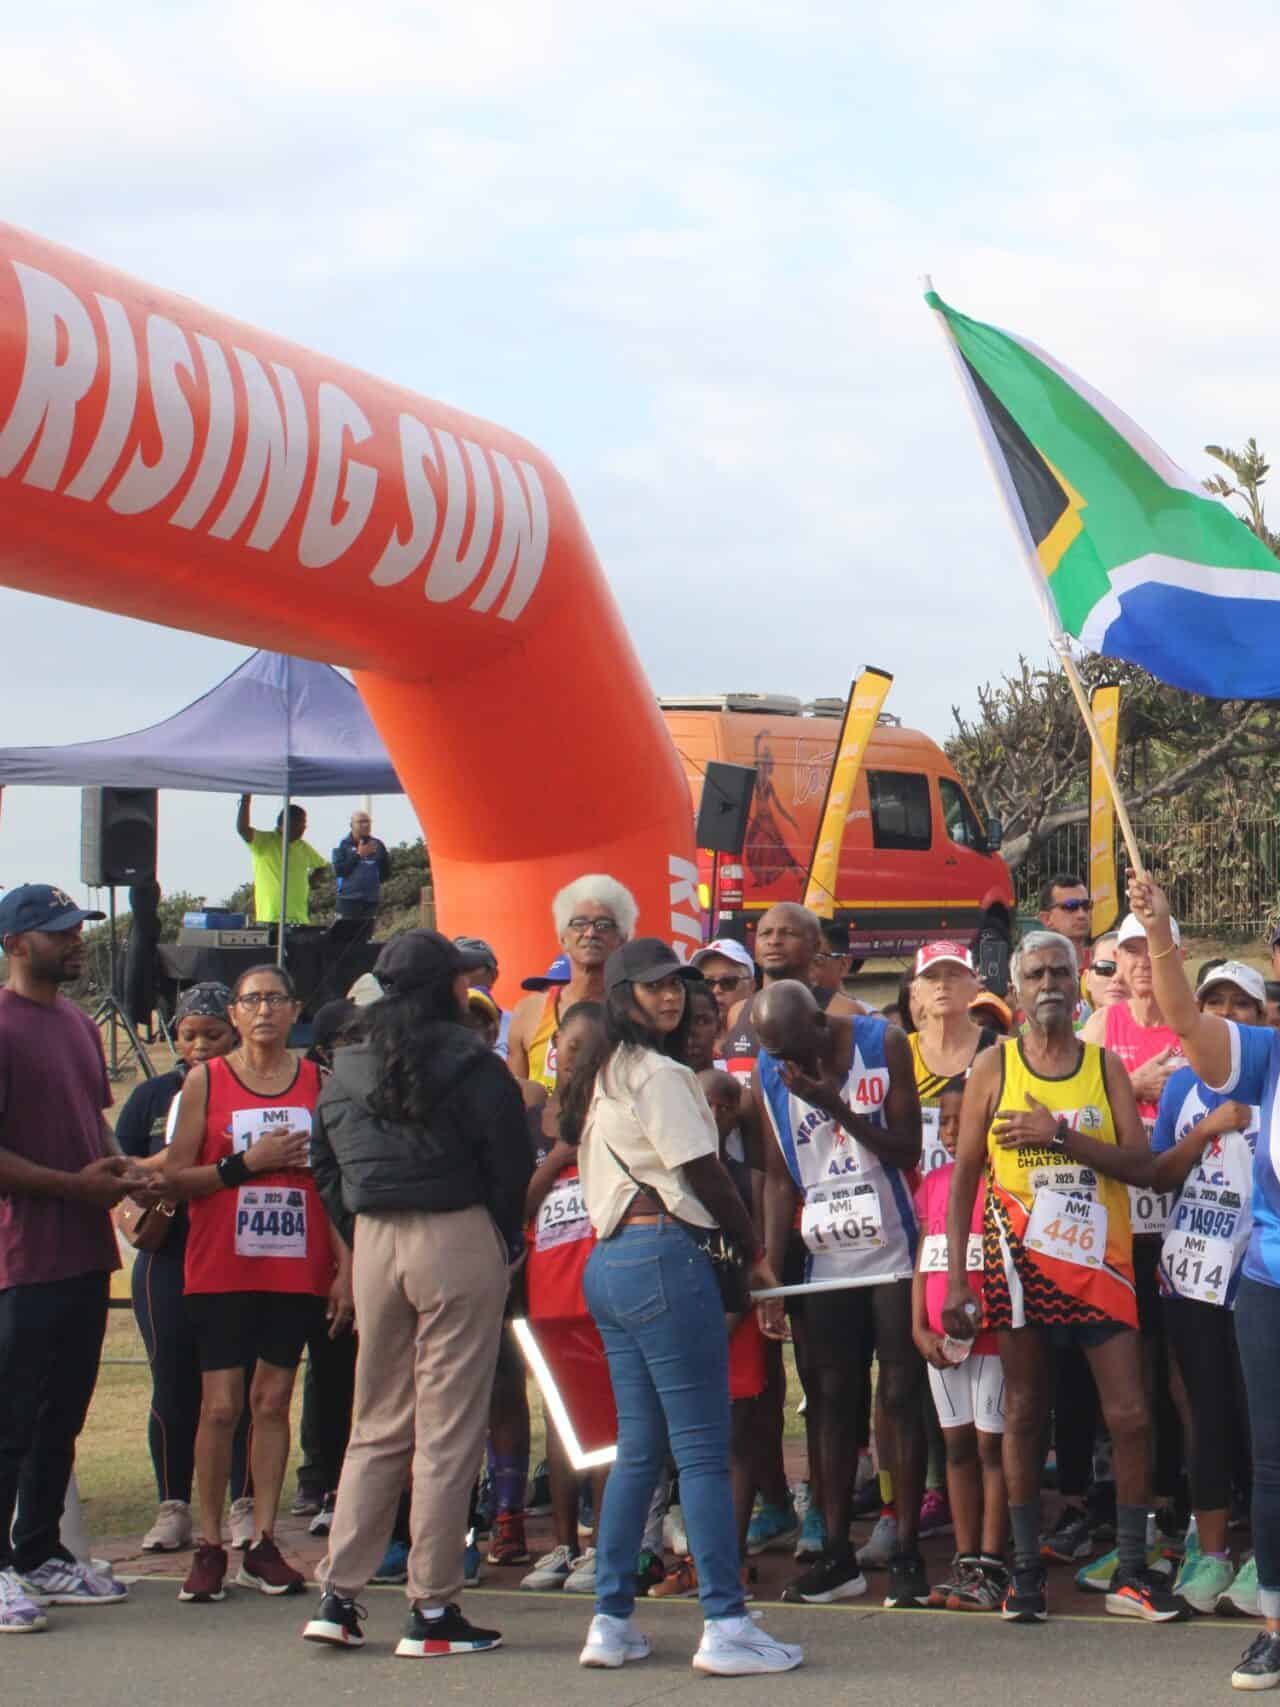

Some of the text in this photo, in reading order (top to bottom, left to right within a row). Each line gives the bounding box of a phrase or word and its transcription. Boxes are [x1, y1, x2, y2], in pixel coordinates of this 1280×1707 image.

[0, 258, 549, 622] RISING SUN
[855, 1076, 884, 1106] 40
[797, 1108, 831, 1146] VERU
[1055, 1173, 1074, 1184] 2025
[237, 1210, 305, 1238] P4484
[809, 1215, 878, 1244] 1105
[1042, 1219, 1095, 1250] 446
[1166, 1252, 1223, 1289] 1414
